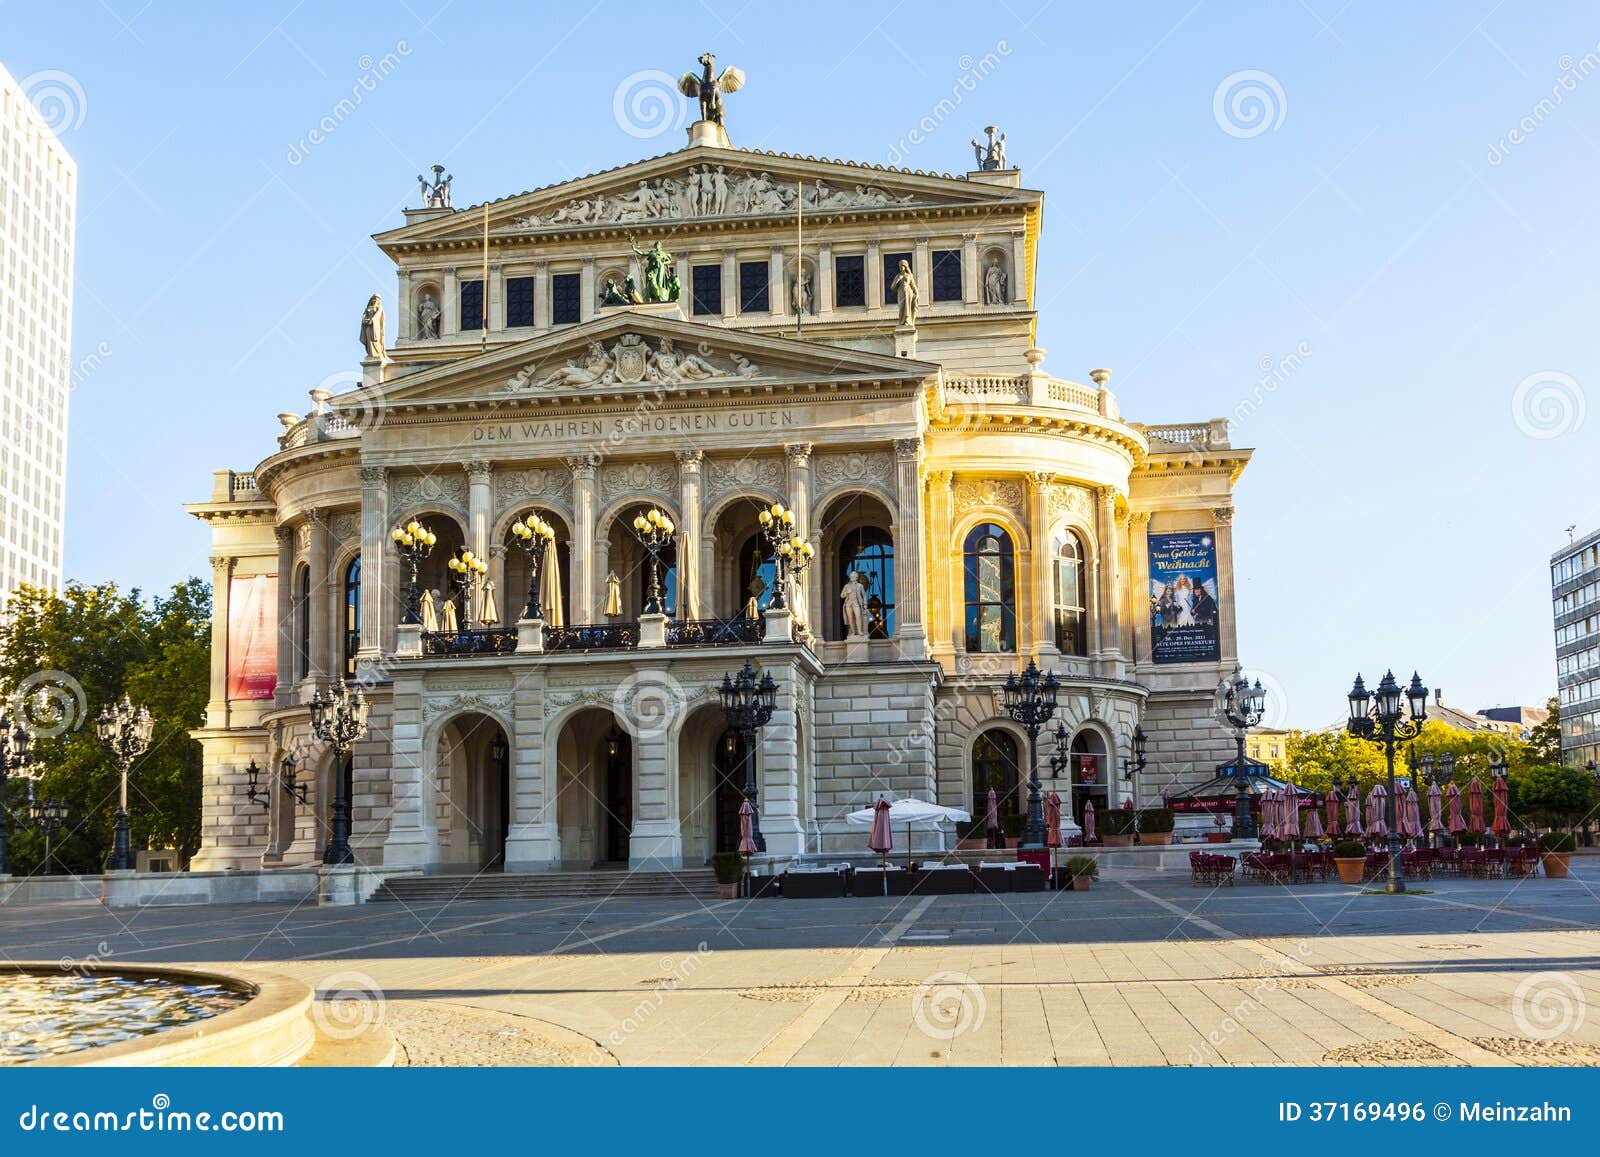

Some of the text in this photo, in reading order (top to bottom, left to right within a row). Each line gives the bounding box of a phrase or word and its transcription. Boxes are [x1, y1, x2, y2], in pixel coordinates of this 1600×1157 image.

[473, 410, 799, 441] DEM WAHREN SCHOENEN GUTEN.
[1171, 548, 1196, 559] Geist
[1156, 558, 1210, 570] Weihnacht
